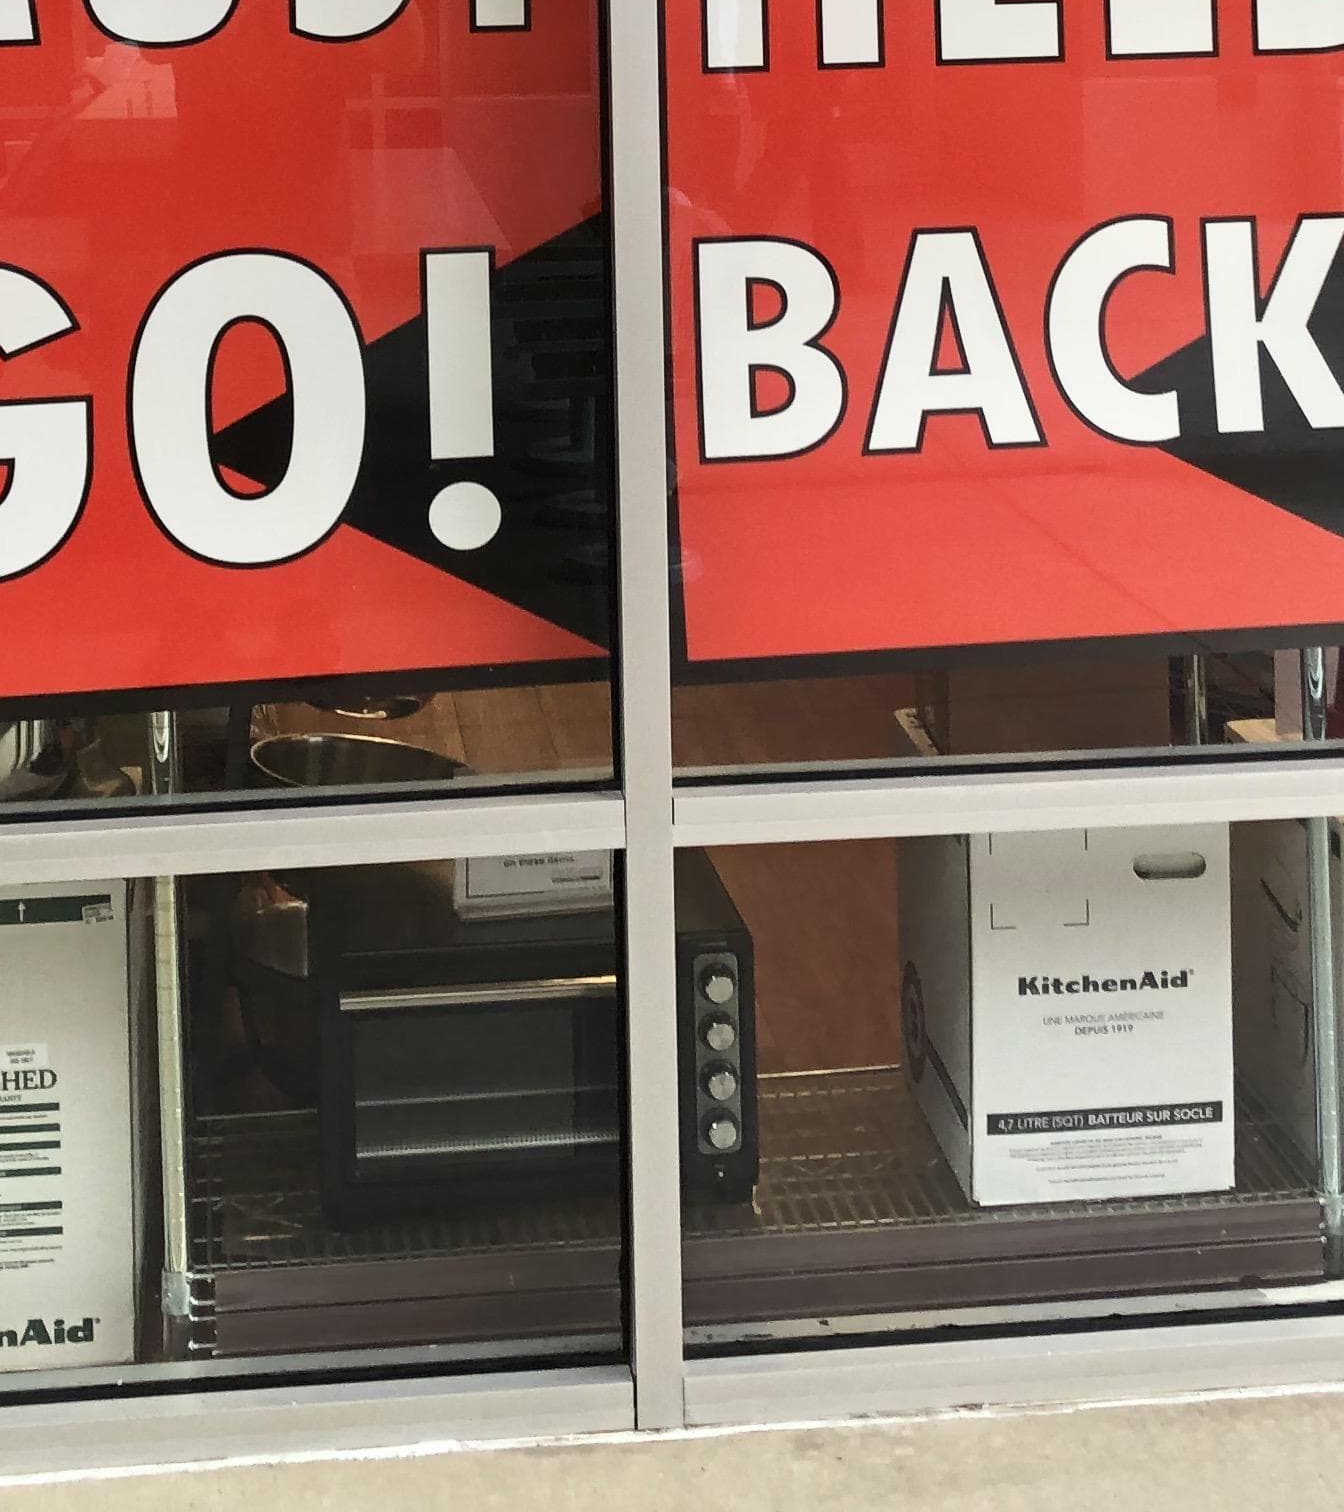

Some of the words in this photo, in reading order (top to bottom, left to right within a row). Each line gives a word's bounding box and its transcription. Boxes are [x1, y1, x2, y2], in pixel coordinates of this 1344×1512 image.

[1017, 969, 1191, 996] KitchenAid
[1042, 1014, 1063, 1026] UNE
[1074, 1026, 1109, 1037] DEPUIS
[1111, 1024, 1134, 1034] 1919
[1017, 1116, 1050, 1130] LITRE
[1088, 1110, 1143, 1127] BATTEUR
[1146, 1109, 1171, 1123] SUR
[1173, 1106, 1214, 1120] SOCLE
